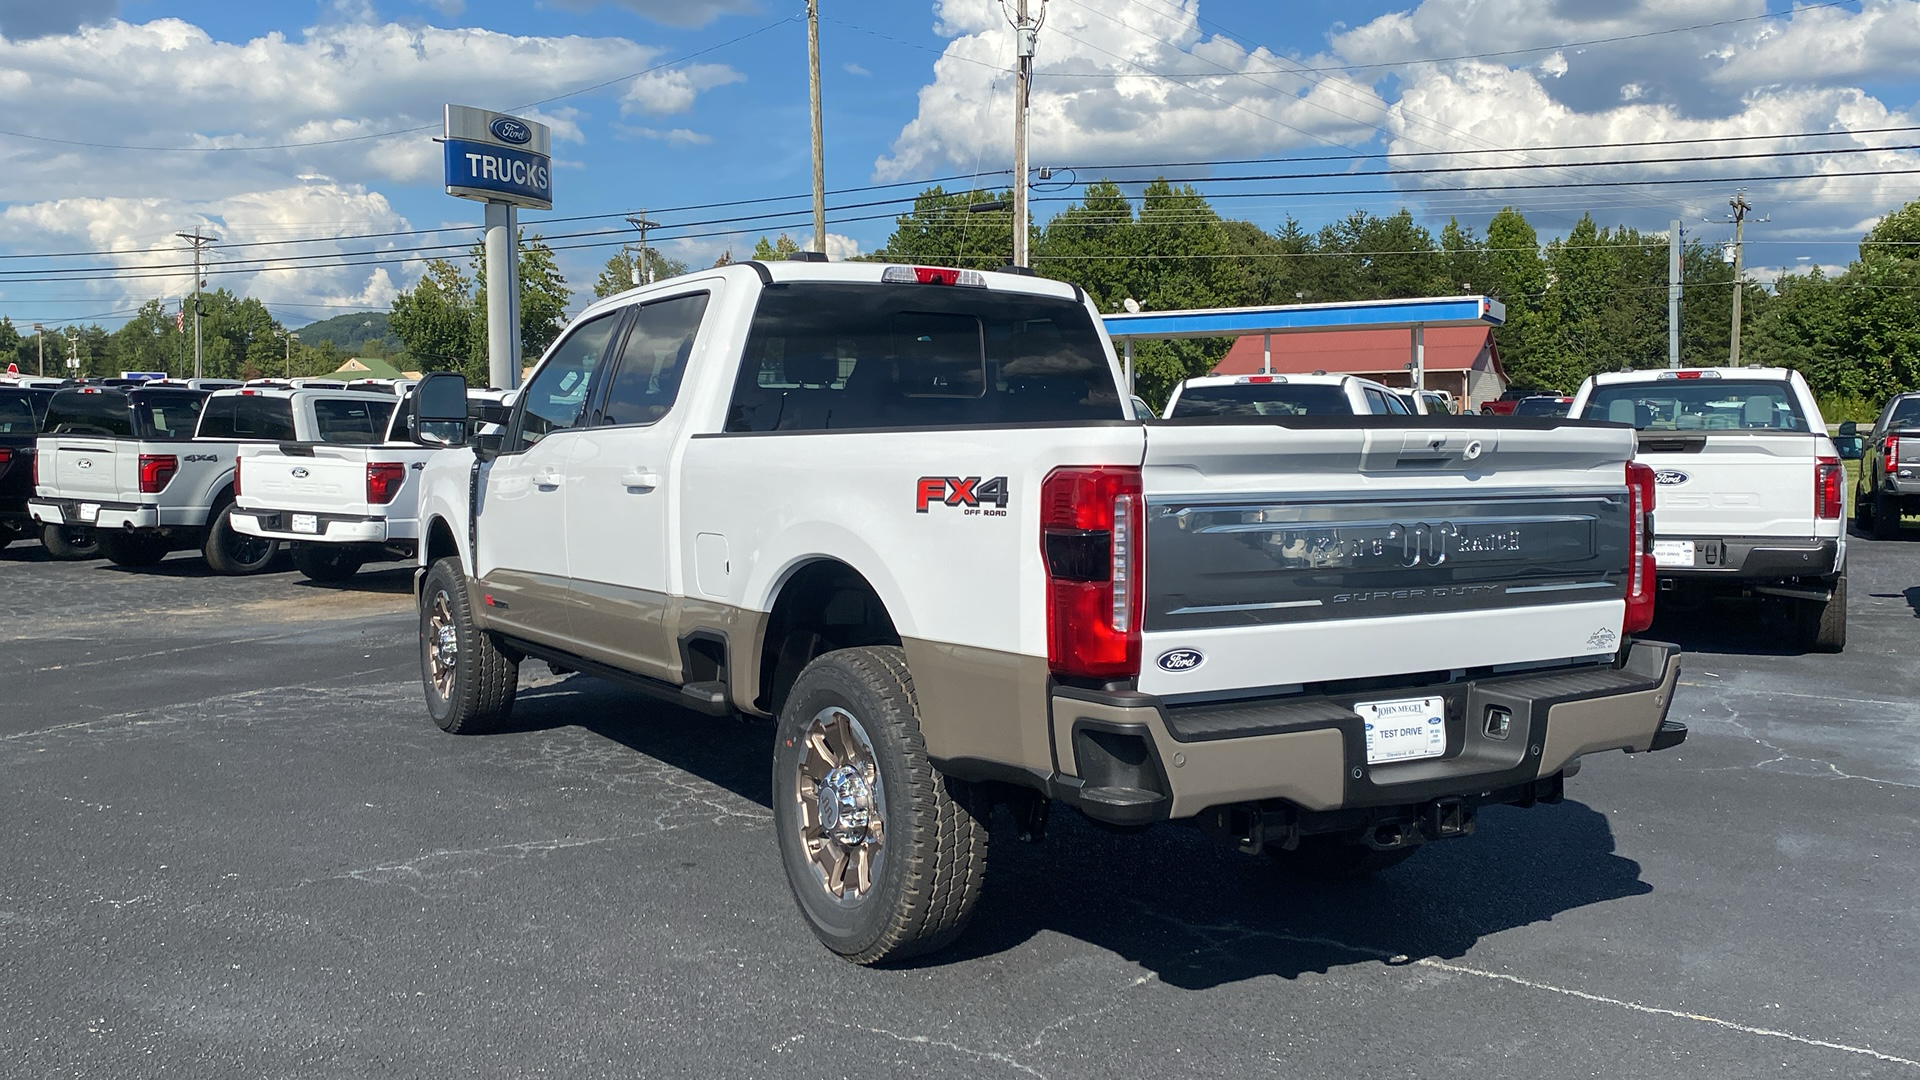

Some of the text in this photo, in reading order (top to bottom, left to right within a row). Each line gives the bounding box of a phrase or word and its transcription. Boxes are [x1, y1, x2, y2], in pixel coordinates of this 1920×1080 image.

[502, 122, 525, 141] Ford
[465, 152, 548, 190] TRUCKS
[1655, 473, 1681, 486] Ford
[916, 476, 1009, 513] FX4
[984, 509, 1007, 517] ROAD
[1314, 530, 1521, 559] KING RANCH
[1333, 584, 1499, 603] SUPER DUTY
[1166, 653, 1196, 668] Ford
[1377, 704, 1424, 718] JOHN MEGEL
[1379, 729, 1399, 739] TEST
[1400, 727, 1423, 737] DRIVE
